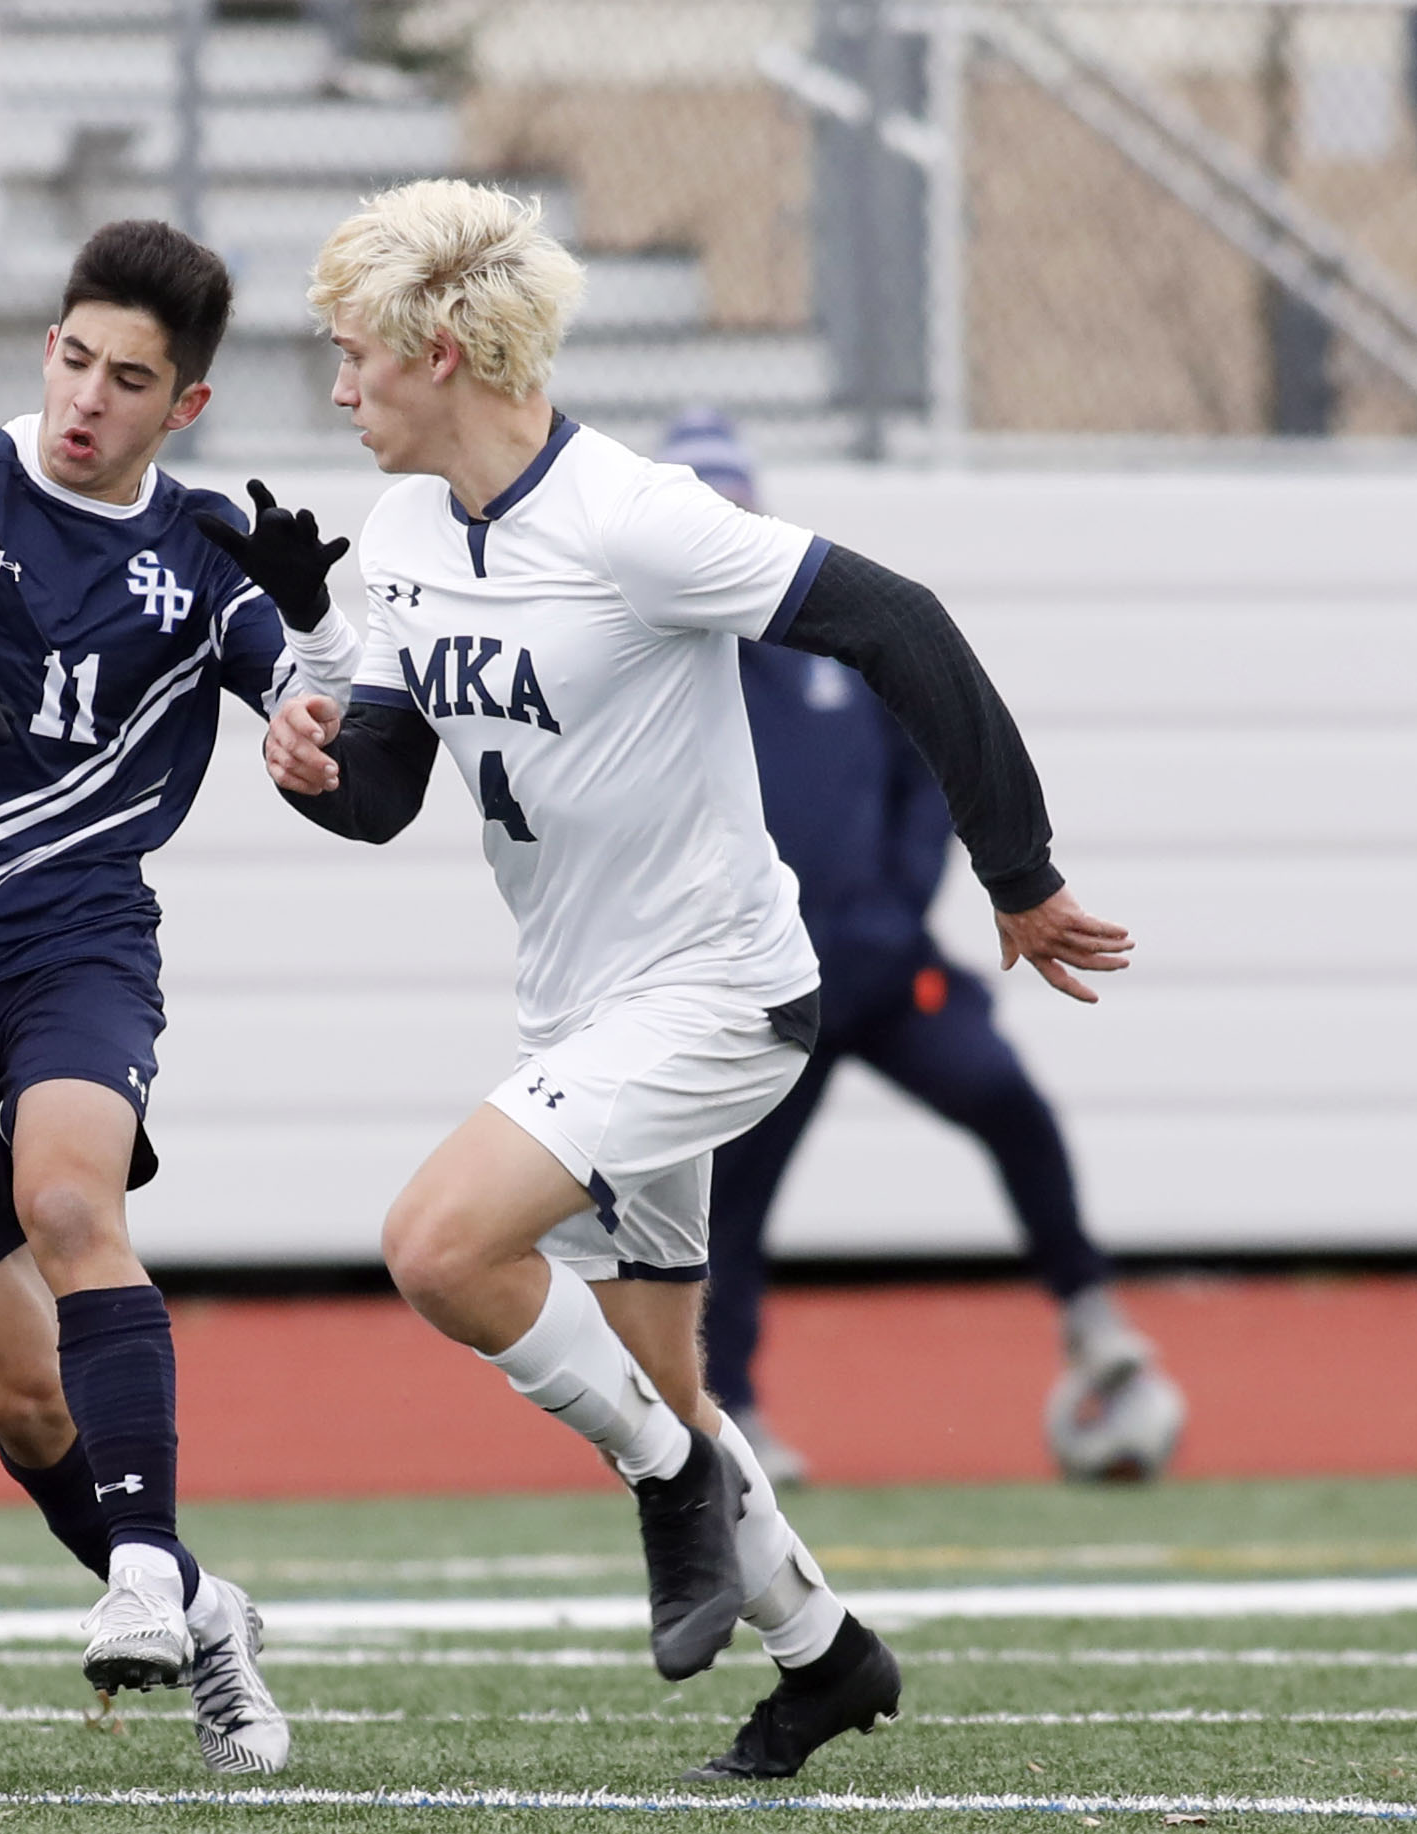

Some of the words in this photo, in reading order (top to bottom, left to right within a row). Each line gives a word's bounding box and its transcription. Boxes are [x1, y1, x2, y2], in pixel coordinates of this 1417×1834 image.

[29, 649, 100, 745] 11
[399, 635, 562, 736] MKA
[479, 750, 538, 842] 4
